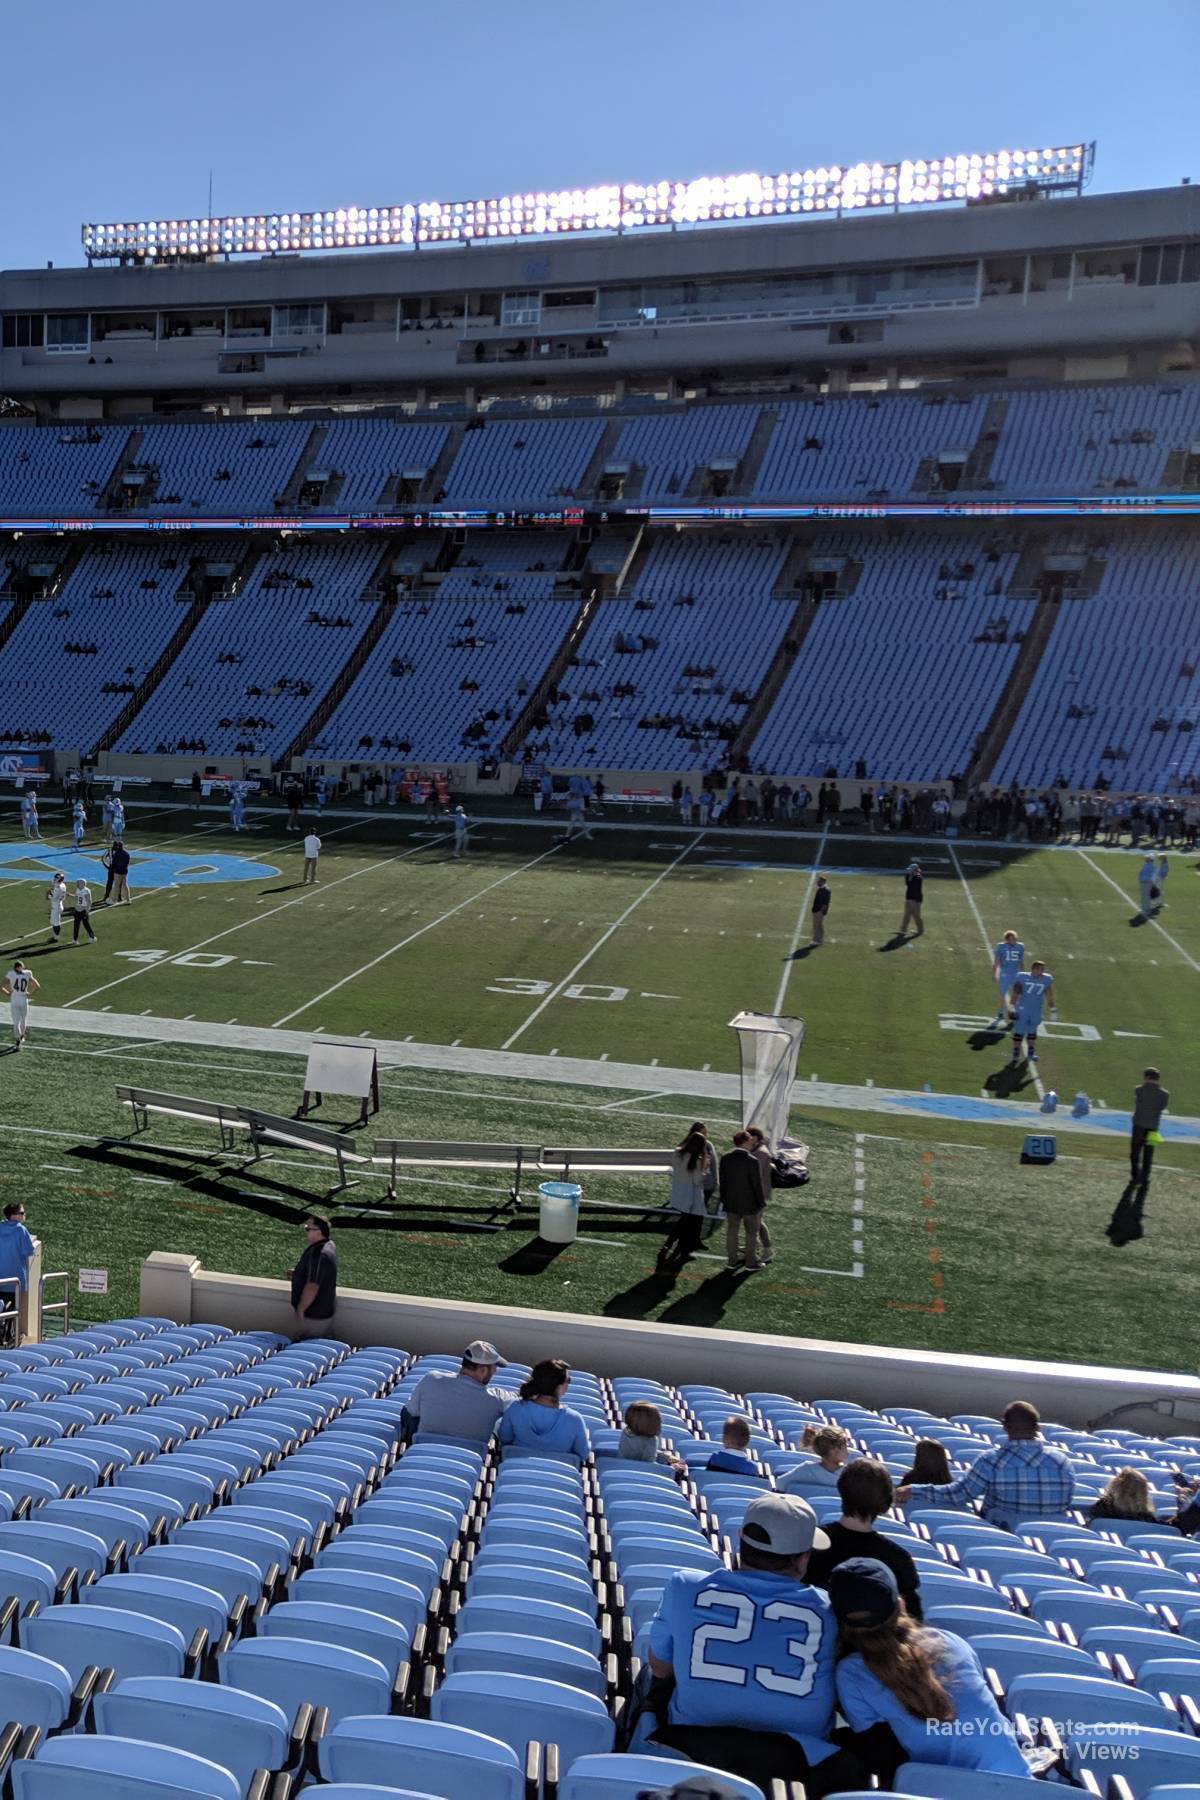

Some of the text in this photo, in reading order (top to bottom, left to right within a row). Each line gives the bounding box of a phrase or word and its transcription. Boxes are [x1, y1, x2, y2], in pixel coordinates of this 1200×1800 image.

[112, 949, 239, 968] 40
[1005, 950, 1020, 962] 15
[13, 977, 28, 993] 40
[485, 977, 631, 1001] 30
[1025, 982, 1045, 996] 77
[938, 1013, 1103, 1041] 20
[1031, 1138, 1055, 1156] 20
[688, 1587, 824, 1698] 23
